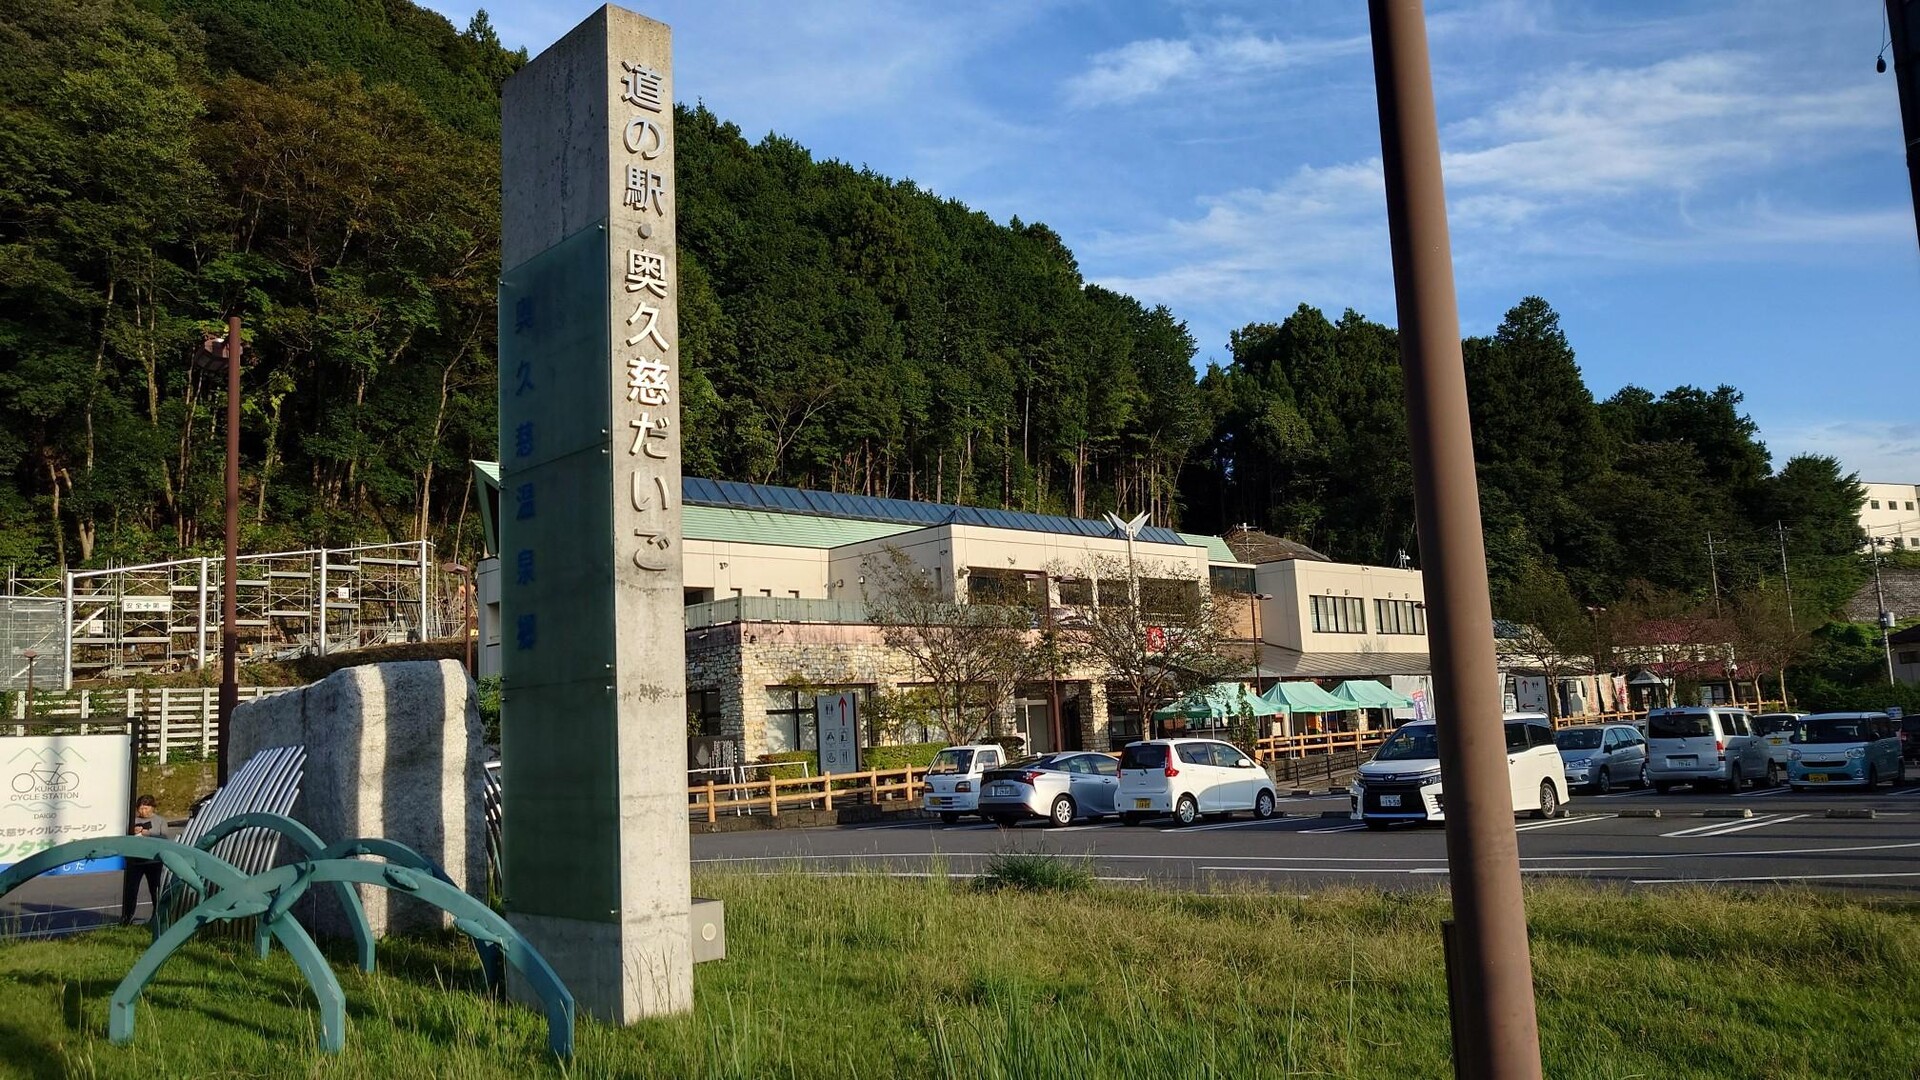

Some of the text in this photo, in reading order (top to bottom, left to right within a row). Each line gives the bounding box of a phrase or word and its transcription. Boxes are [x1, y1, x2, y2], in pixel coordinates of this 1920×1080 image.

[621, 60, 671, 572] 道の駅・奥久慈だいご
[34, 785, 66, 793] KUKUJI
[42, 792, 79, 800] STATION
